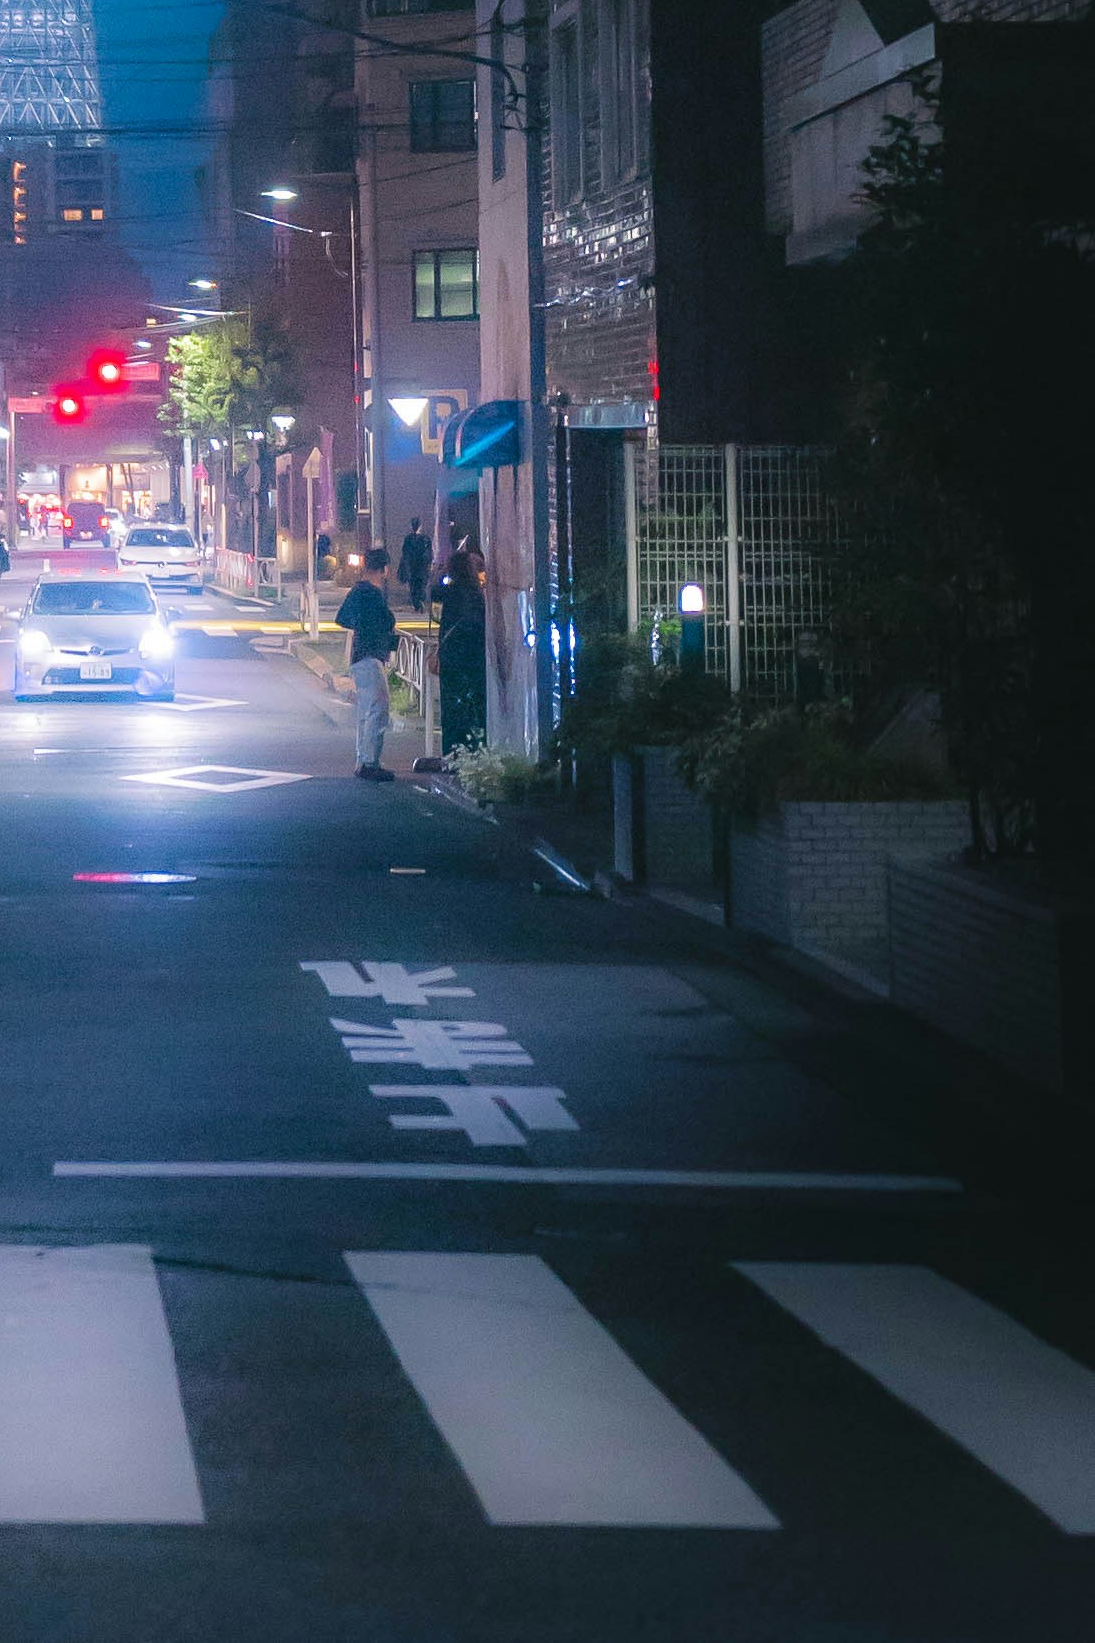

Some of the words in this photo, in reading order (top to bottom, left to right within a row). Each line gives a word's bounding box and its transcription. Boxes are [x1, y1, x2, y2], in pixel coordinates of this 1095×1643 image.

[429, 397, 460, 439] P
[297, 960, 581, 1146] 止まれ
